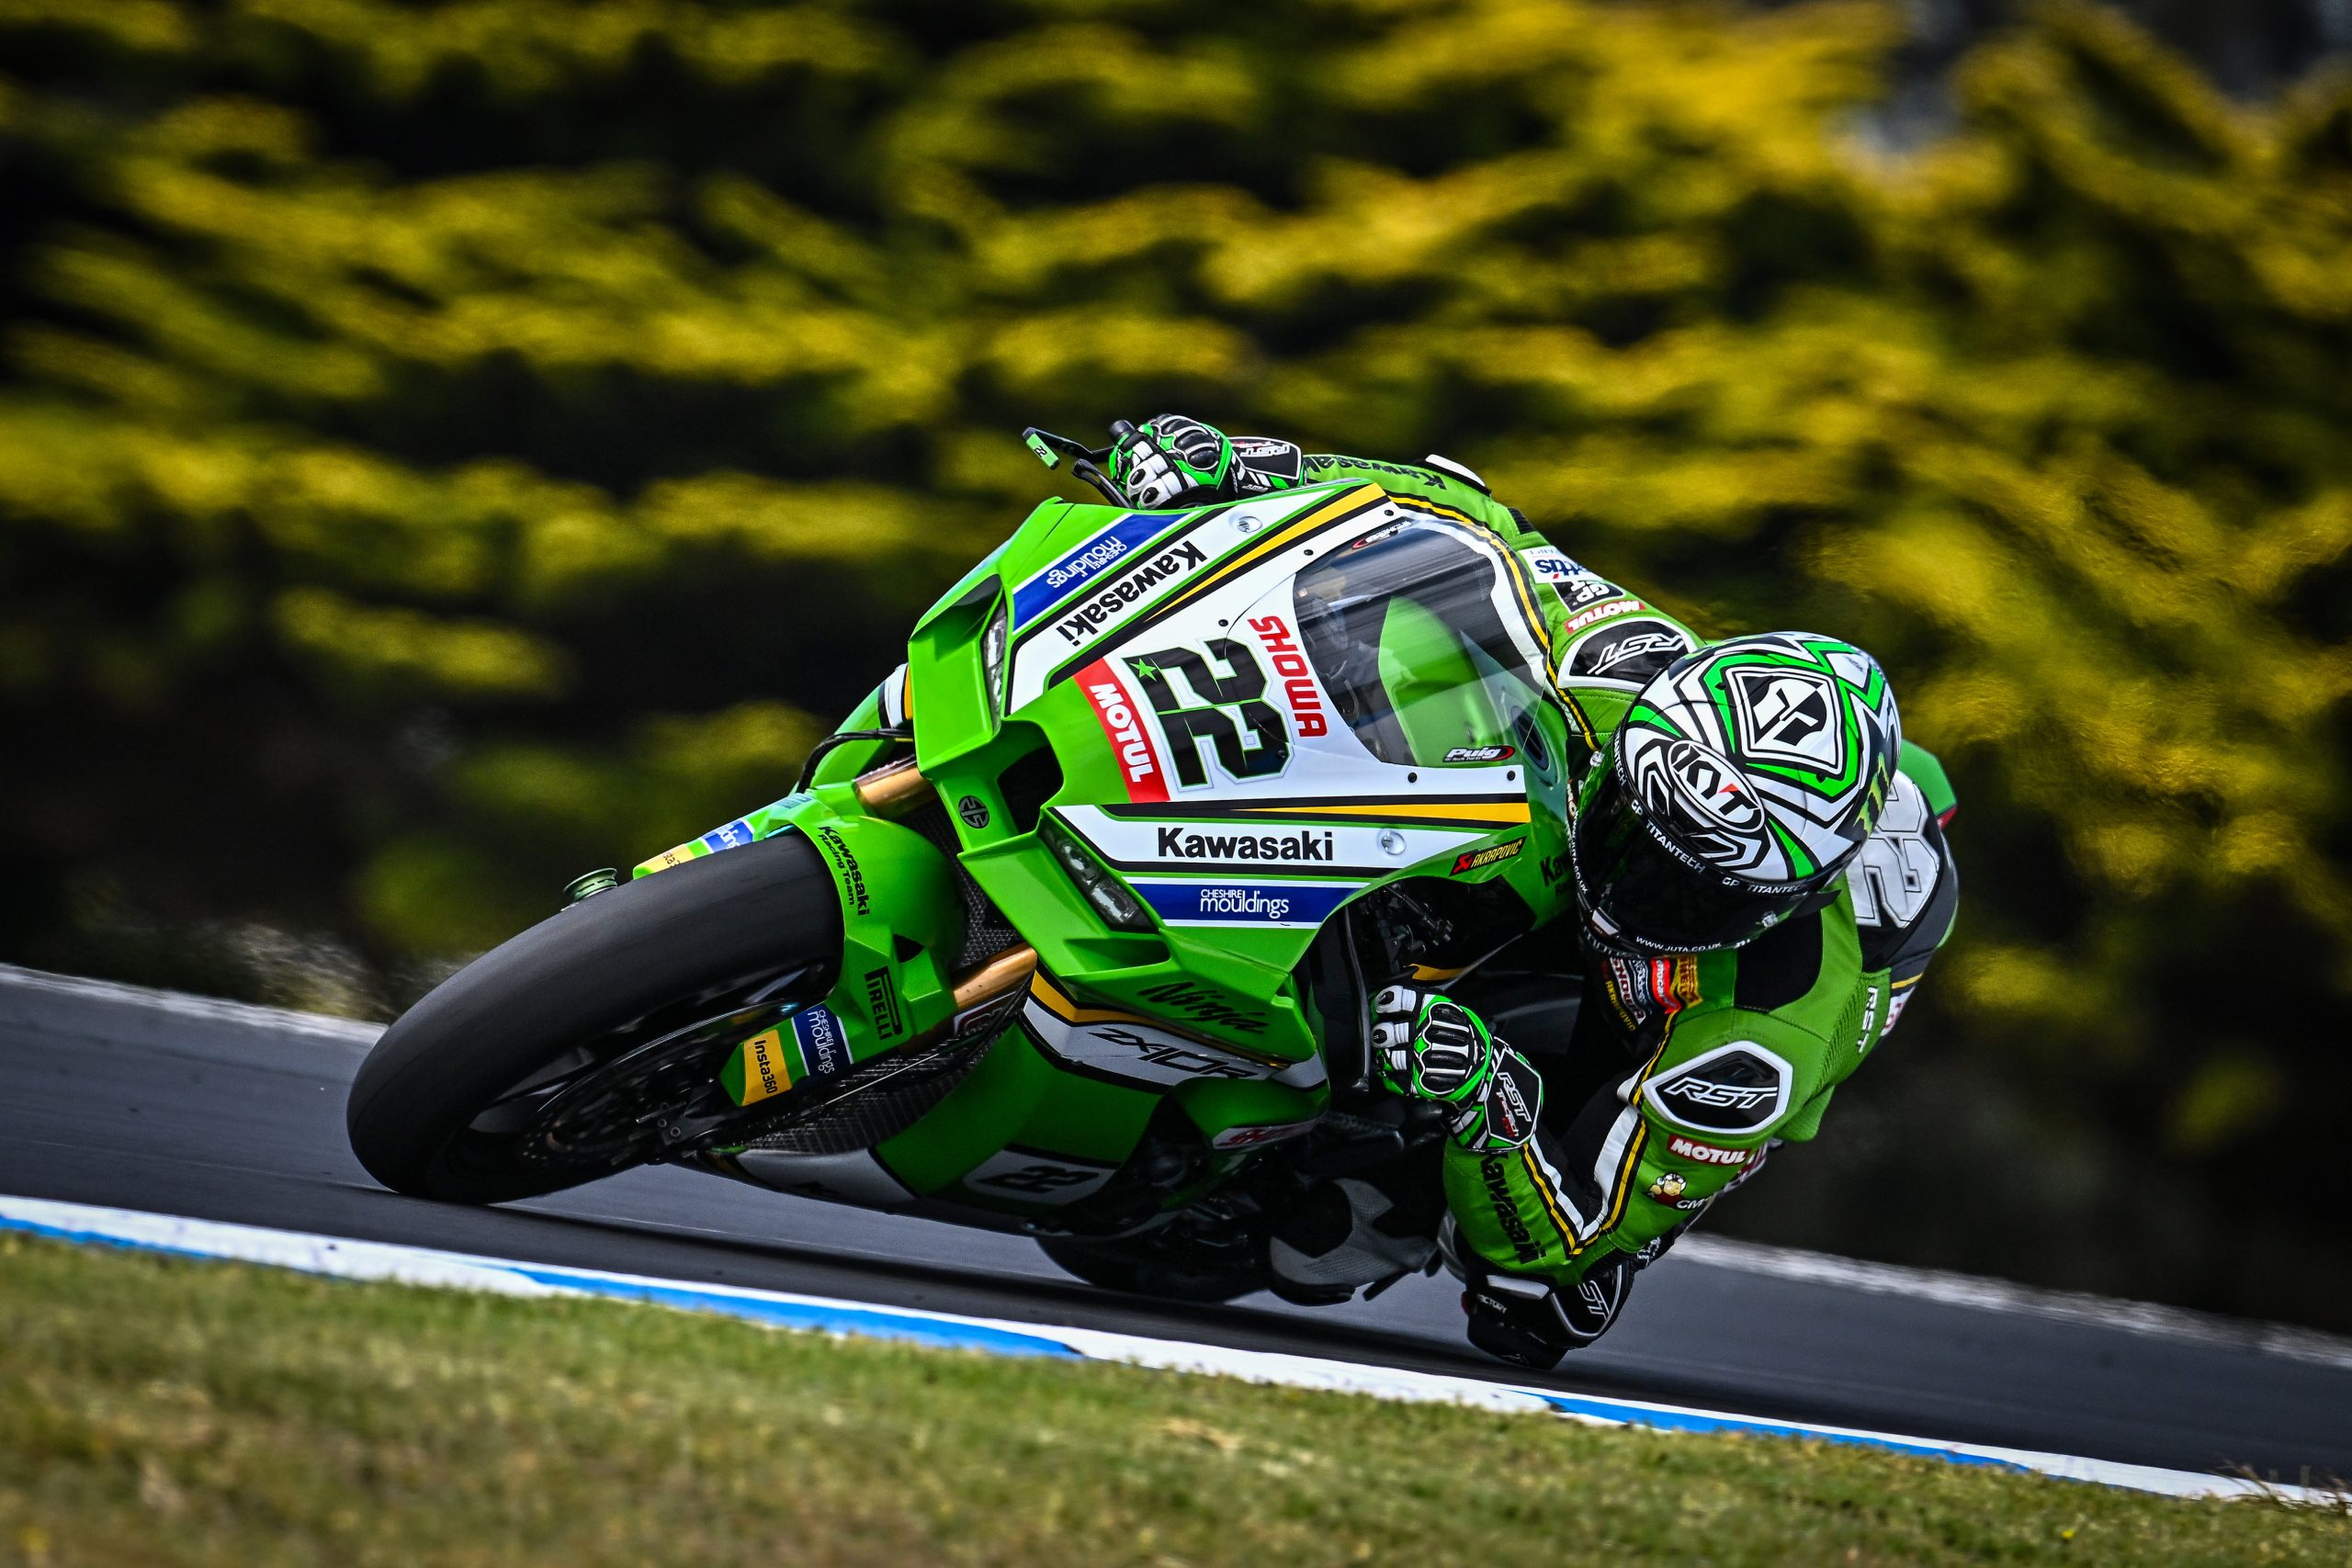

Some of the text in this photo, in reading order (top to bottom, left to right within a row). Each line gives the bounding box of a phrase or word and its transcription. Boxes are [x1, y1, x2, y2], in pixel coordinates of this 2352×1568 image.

[1046, 536, 1122, 588] mouldings
[1095, 544, 1127, 570] CHESHIRE
[1056, 540, 1208, 647] Kawasaki
[1567, 600, 1640, 630] MOTUL
[1248, 615, 1329, 738] SHOWA
[1587, 633, 1685, 675] RST
[1089, 682, 1154, 783] MOTUL
[1121, 637, 1290, 788] 22
[1446, 747, 1501, 760] Puig
[1671, 742, 1760, 816] KYT
[1631, 799, 1644, 816] GP
[1158, 827, 1333, 861] Kawasaki
[1645, 819, 1706, 873] TITANTECH
[817, 834, 854, 906] Racing Team
[818, 826, 870, 917] Kawasaki
[1201, 889, 1242, 898] CHESHIRE
[1721, 876, 1740, 886] GP
[1200, 890, 1289, 919] mouldings
[1635, 936, 1722, 953] WWW.JUTA.CO.UK
[818, 1010, 834, 1044] CHESHIRE
[865, 965, 902, 1040] PIRELLI
[1137, 982, 1270, 1034] Ninja
[1857, 987, 1879, 1053] RST
[754, 1039, 778, 1094] Insta360
[807, 1010, 837, 1074] mouldings
[1497, 1072, 1532, 1122] RST
[1664, 1077, 1779, 1110] RST
[1670, 1138, 1747, 1164] MOTUL
